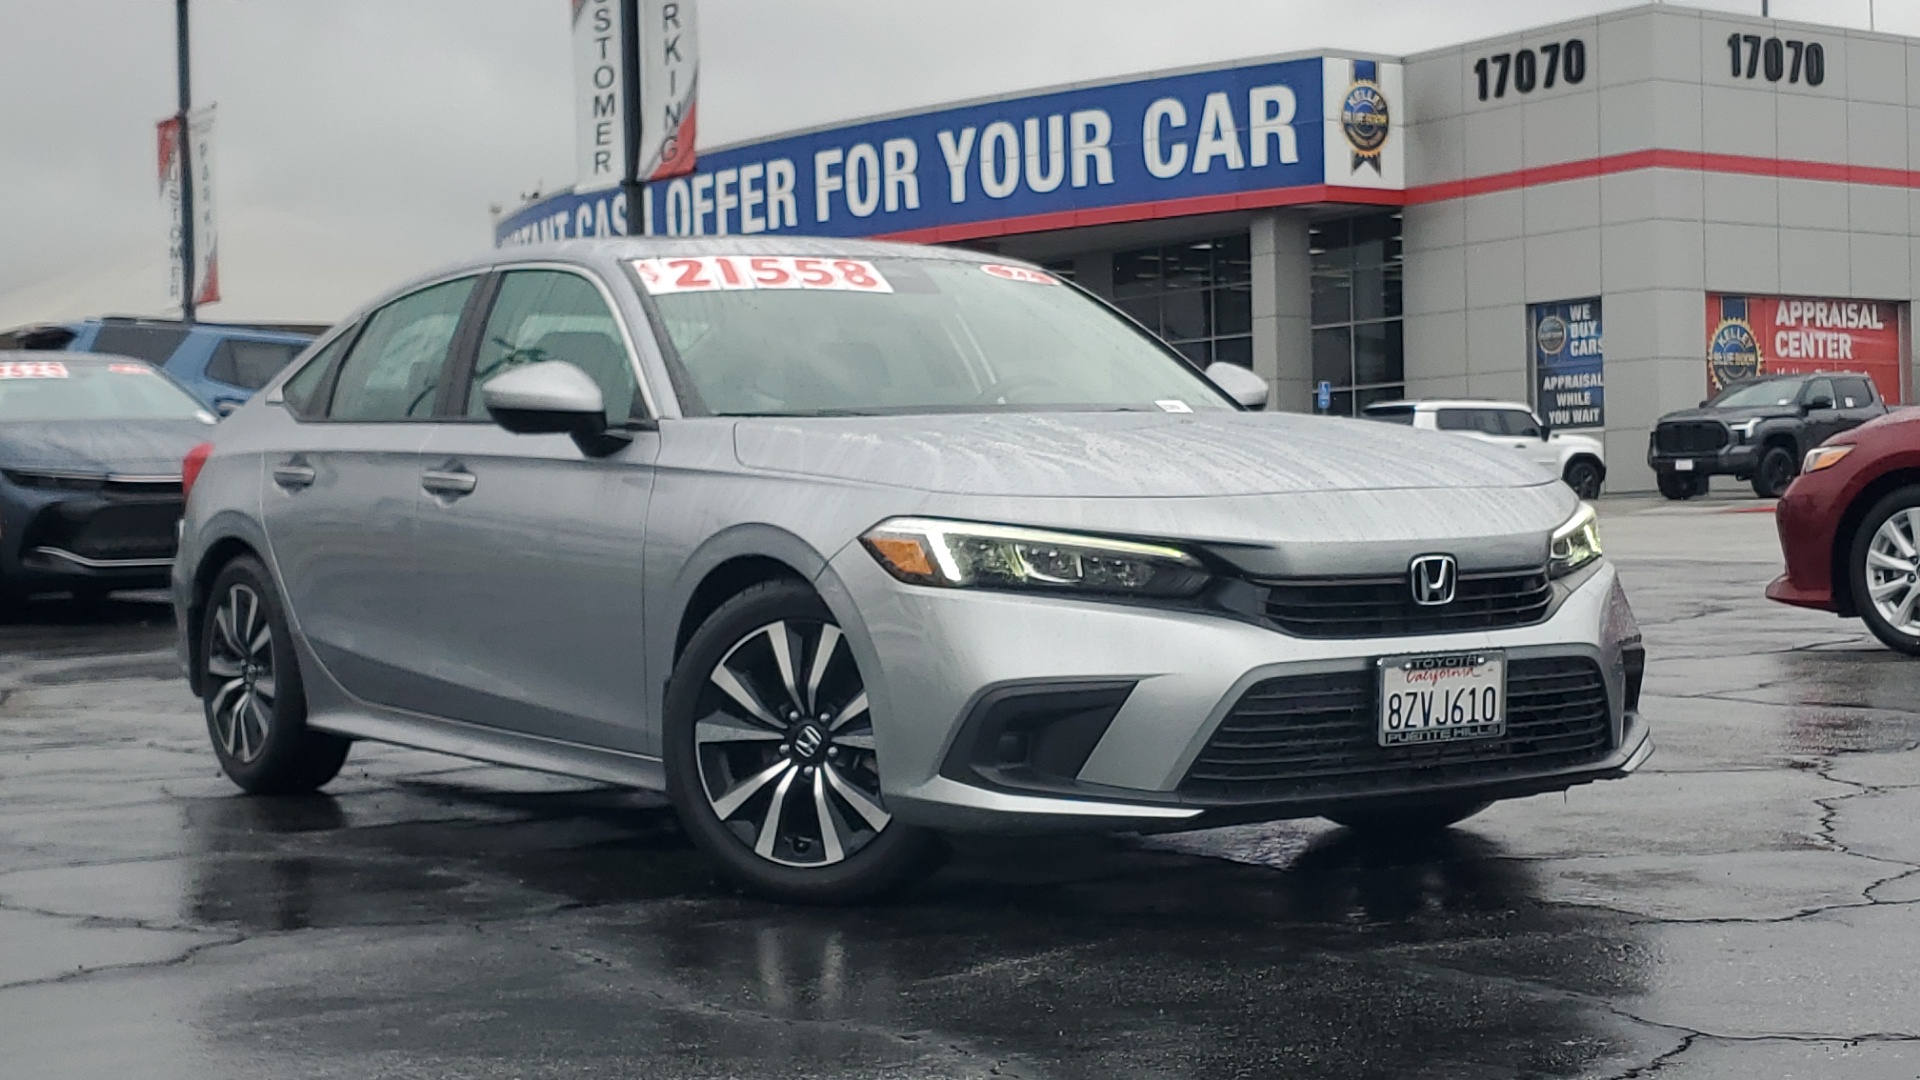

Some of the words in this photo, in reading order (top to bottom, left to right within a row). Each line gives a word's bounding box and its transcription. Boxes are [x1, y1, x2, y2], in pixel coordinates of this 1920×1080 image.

[1474, 39, 1585, 101] 17070
[1728, 33, 1824, 86] 17070
[594, 0, 615, 174] STOMER
[666, 158, 798, 237] OFFER
[815, 138, 920, 223] FOR
[937, 109, 1115, 203] YOUR
[1143, 85, 1299, 180] CAR
[1570, 304, 1590, 321] WE
[1775, 300, 1884, 329] APPRAISAL
[1570, 321, 1597, 339] BUY
[1717, 327, 1754, 349] KELLEY
[1775, 331, 1852, 359] CENTER
[1543, 374, 1603, 391] APPRAISAL
[1556, 391, 1591, 407] WHILE
[1548, 409, 1570, 424] YOU
[1572, 408, 1599, 424] WAIT
[1415, 655, 1477, 668] TOYOTA
[1406, 667, 1482, 687] California
[1388, 686, 1496, 730] 8ZVJ610
